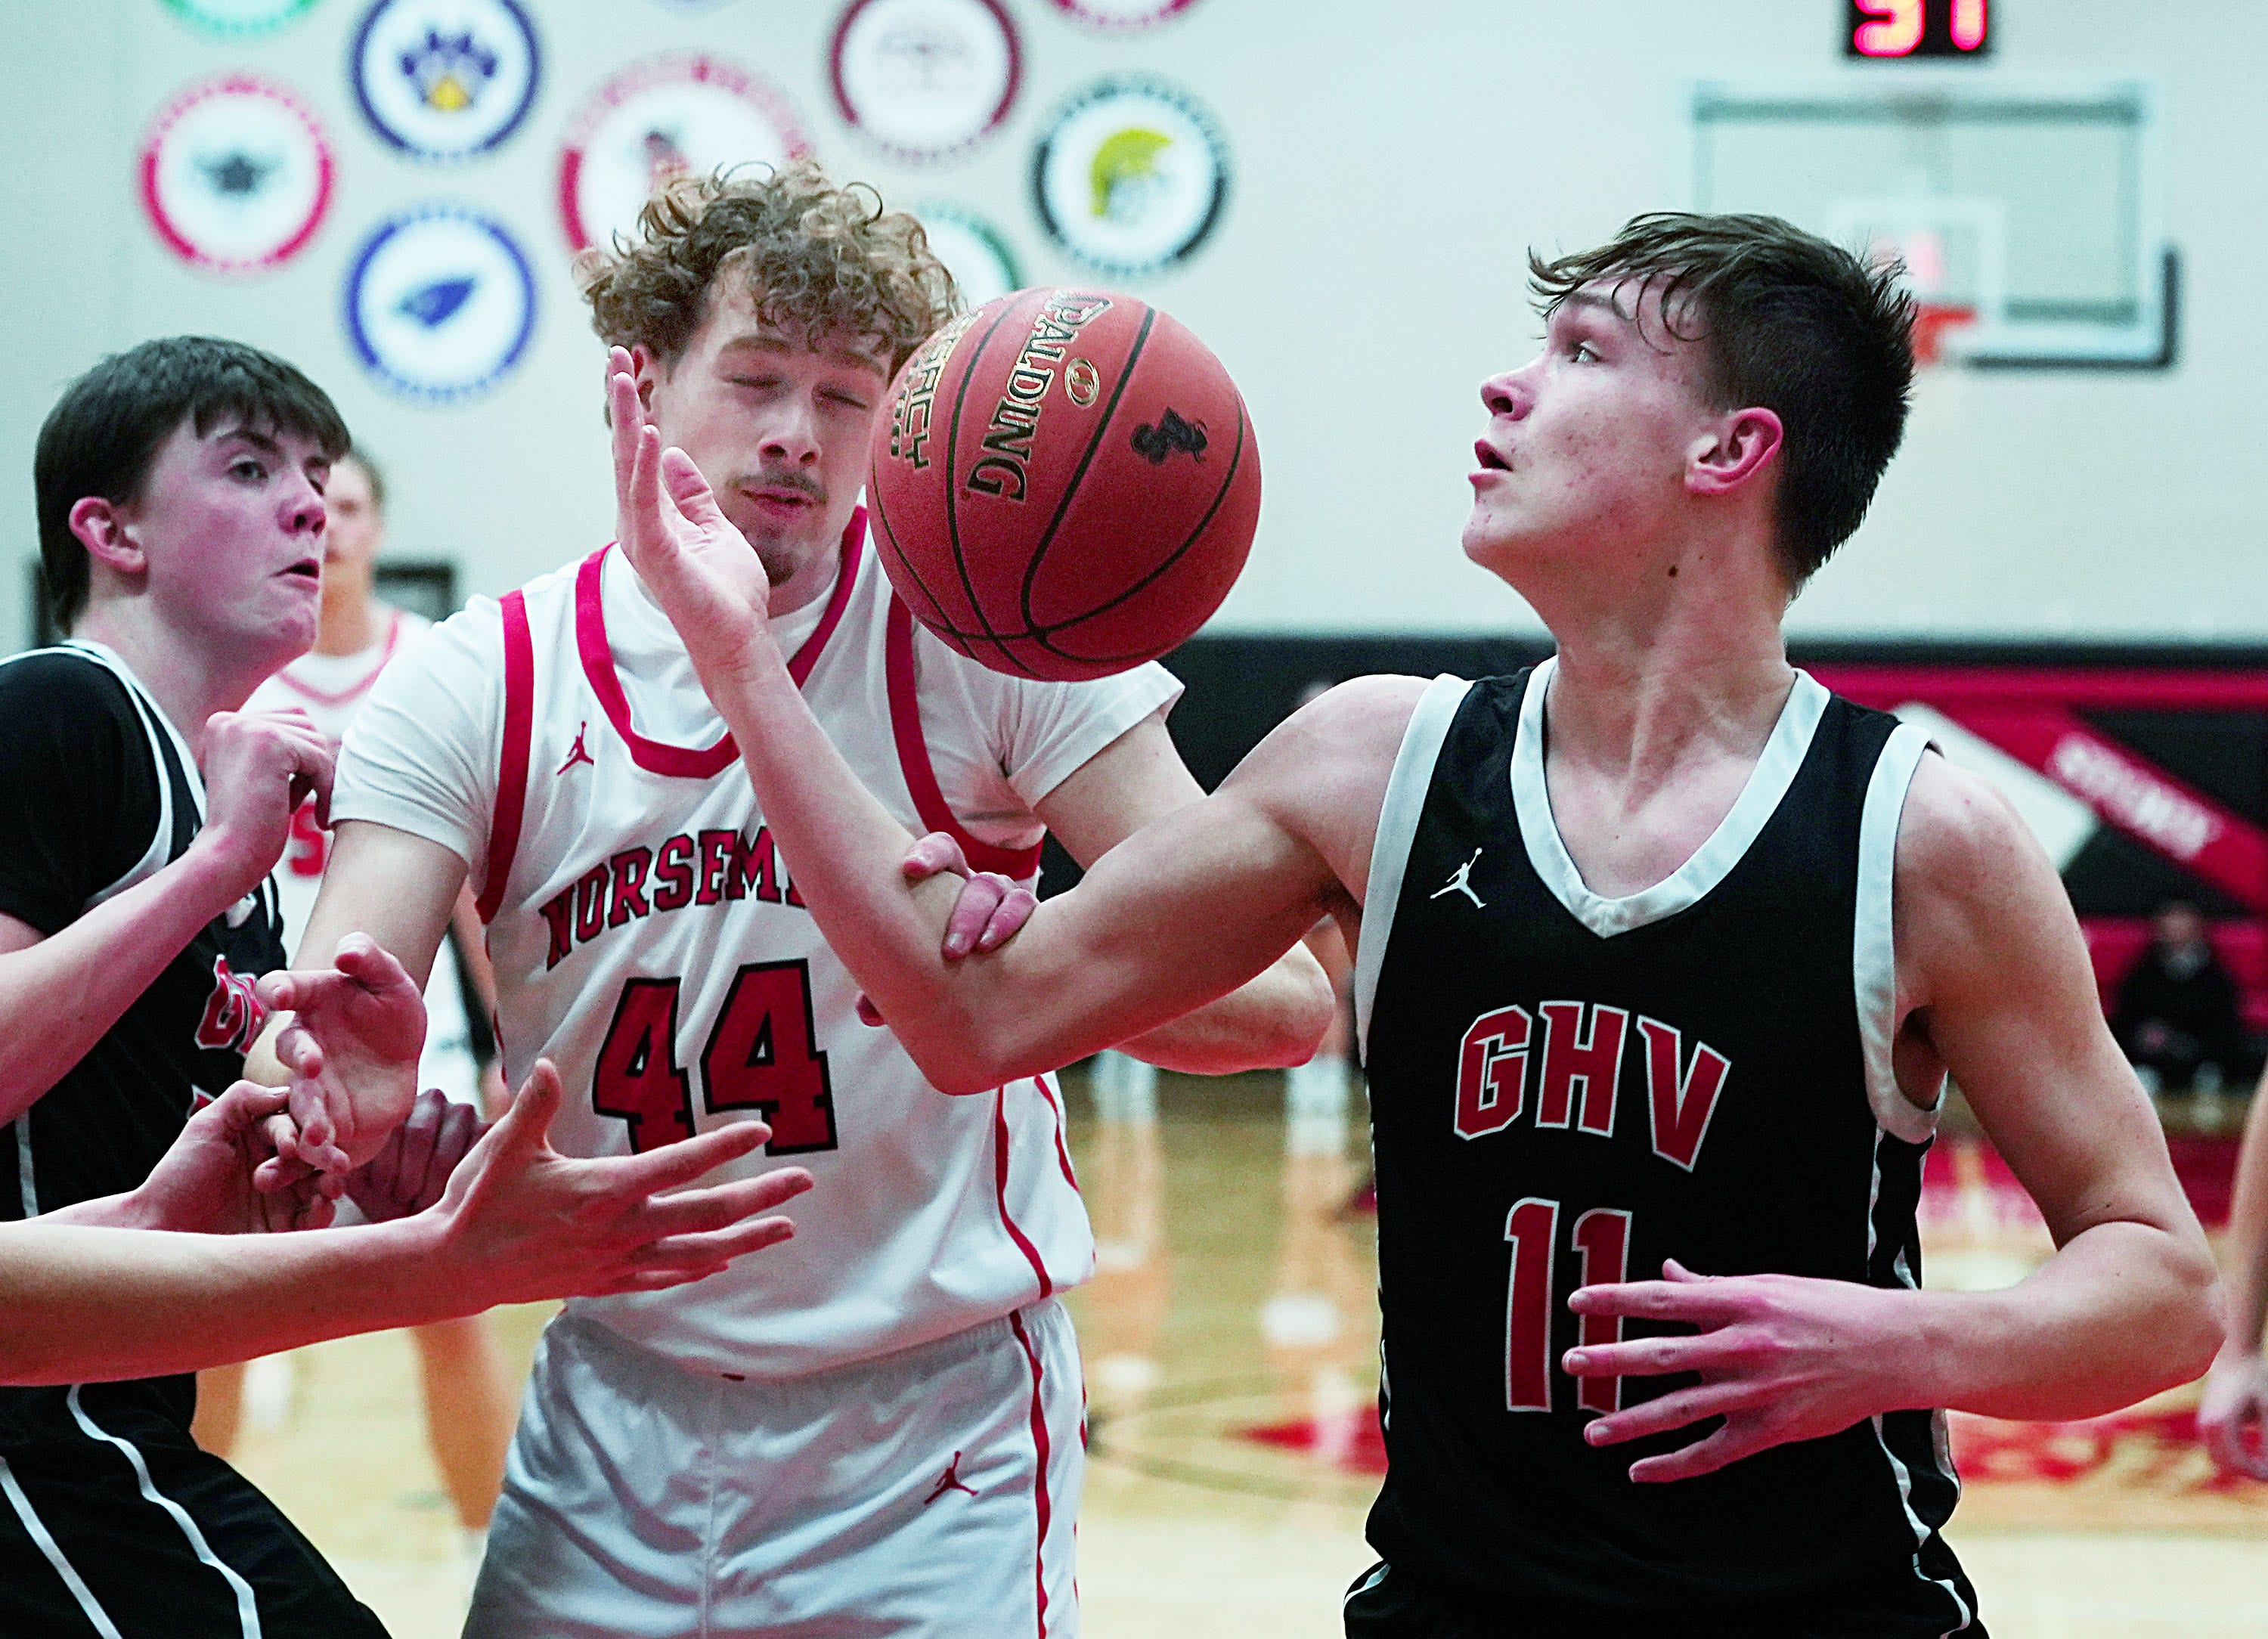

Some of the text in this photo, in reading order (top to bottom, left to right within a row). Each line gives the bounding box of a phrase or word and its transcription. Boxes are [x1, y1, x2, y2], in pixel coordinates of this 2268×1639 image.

[538, 826, 808, 971] NORSEM
[593, 959, 838, 1157] 44
[1453, 999, 1731, 1173] GHV
[1504, 1196, 1633, 1414] 11
